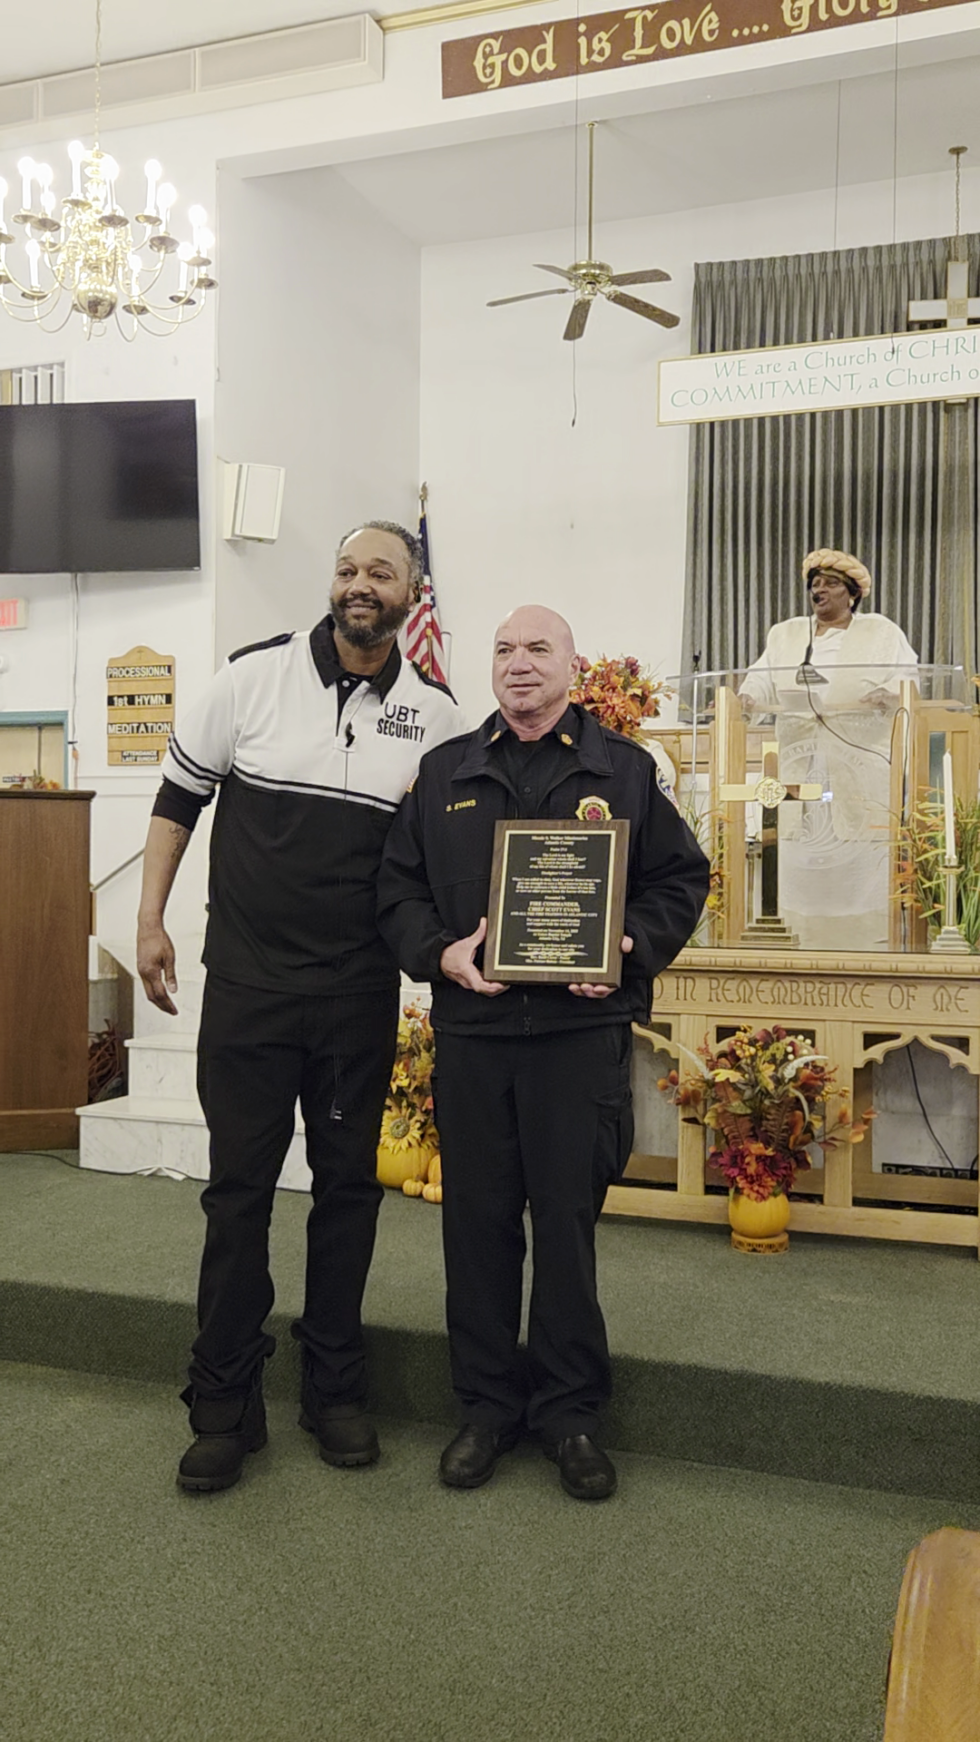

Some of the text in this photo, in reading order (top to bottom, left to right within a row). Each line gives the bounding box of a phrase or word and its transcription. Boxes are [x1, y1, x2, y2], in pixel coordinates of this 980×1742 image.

[473, 26, 556, 89] God
[578, 23, 619, 66] is
[621, 3, 720, 61] Love
[713, 359, 748, 378] WE
[754, 361, 782, 376] are
[787, 361, 798, 372] a
[803, 346, 877, 370] Church
[883, 342, 903, 365] of
[670, 373, 864, 408] COMMITMENT,
[868, 377, 880, 389] a
[885, 363, 961, 388] Church
[107, 665, 171, 678] PROCESSIONAL
[113, 694, 166, 706] 1st HYMN
[384, 702, 420, 724] UBT
[107, 722, 171, 734] MEDITATION
[377, 718, 426, 743] SECURITY
[454, 799, 476, 810] EVANS
[674, 976, 697, 1001] IN
[708, 976, 875, 1009] REMEMBRANCE
[888, 983, 918, 1011] OF
[932, 984, 970, 1013] ME
